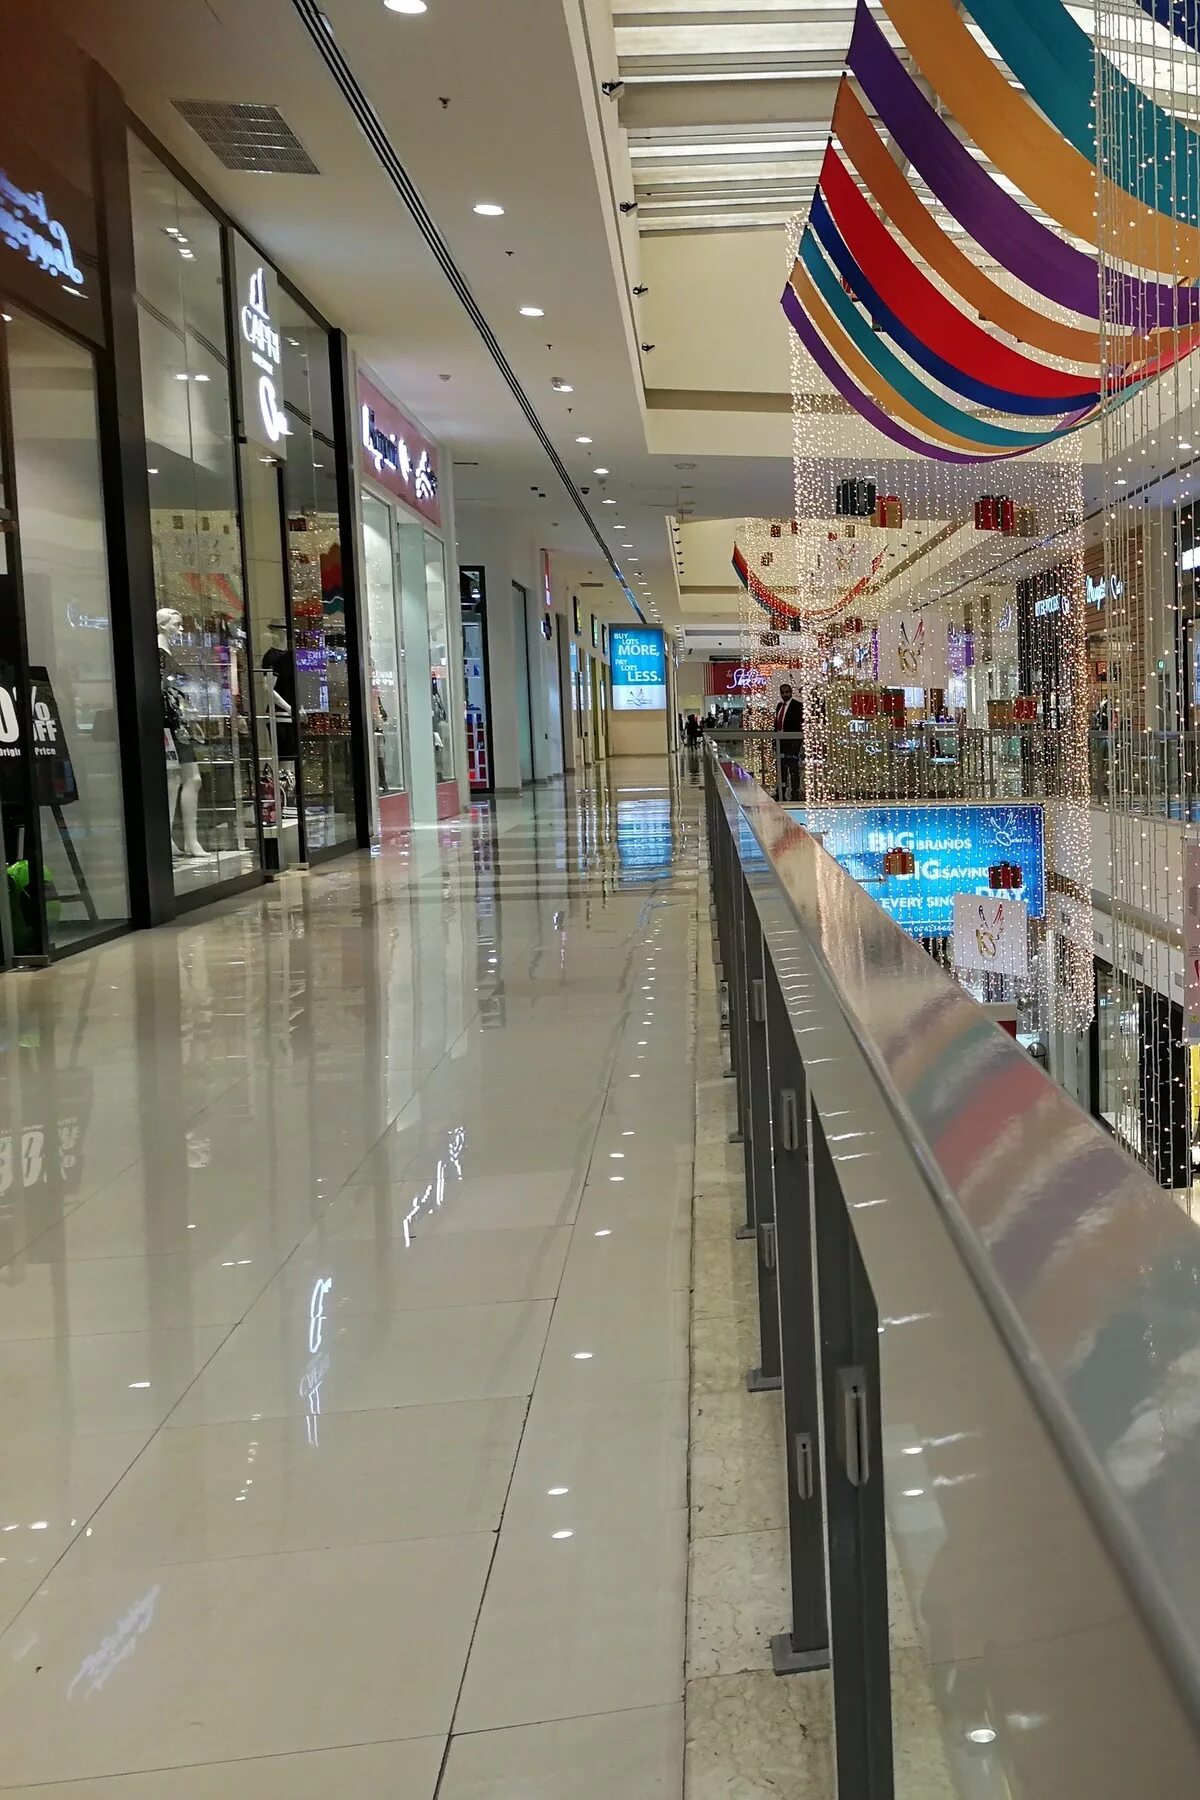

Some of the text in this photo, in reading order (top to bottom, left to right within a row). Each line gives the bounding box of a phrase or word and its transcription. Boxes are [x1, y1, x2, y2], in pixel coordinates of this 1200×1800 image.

[618, 644, 660, 657] MORE,
[614, 658, 628, 666] PAY
[627, 671, 662, 682] LESS.
[34, 747, 56, 756] Price
[917, 838, 972, 850] BRANDS
